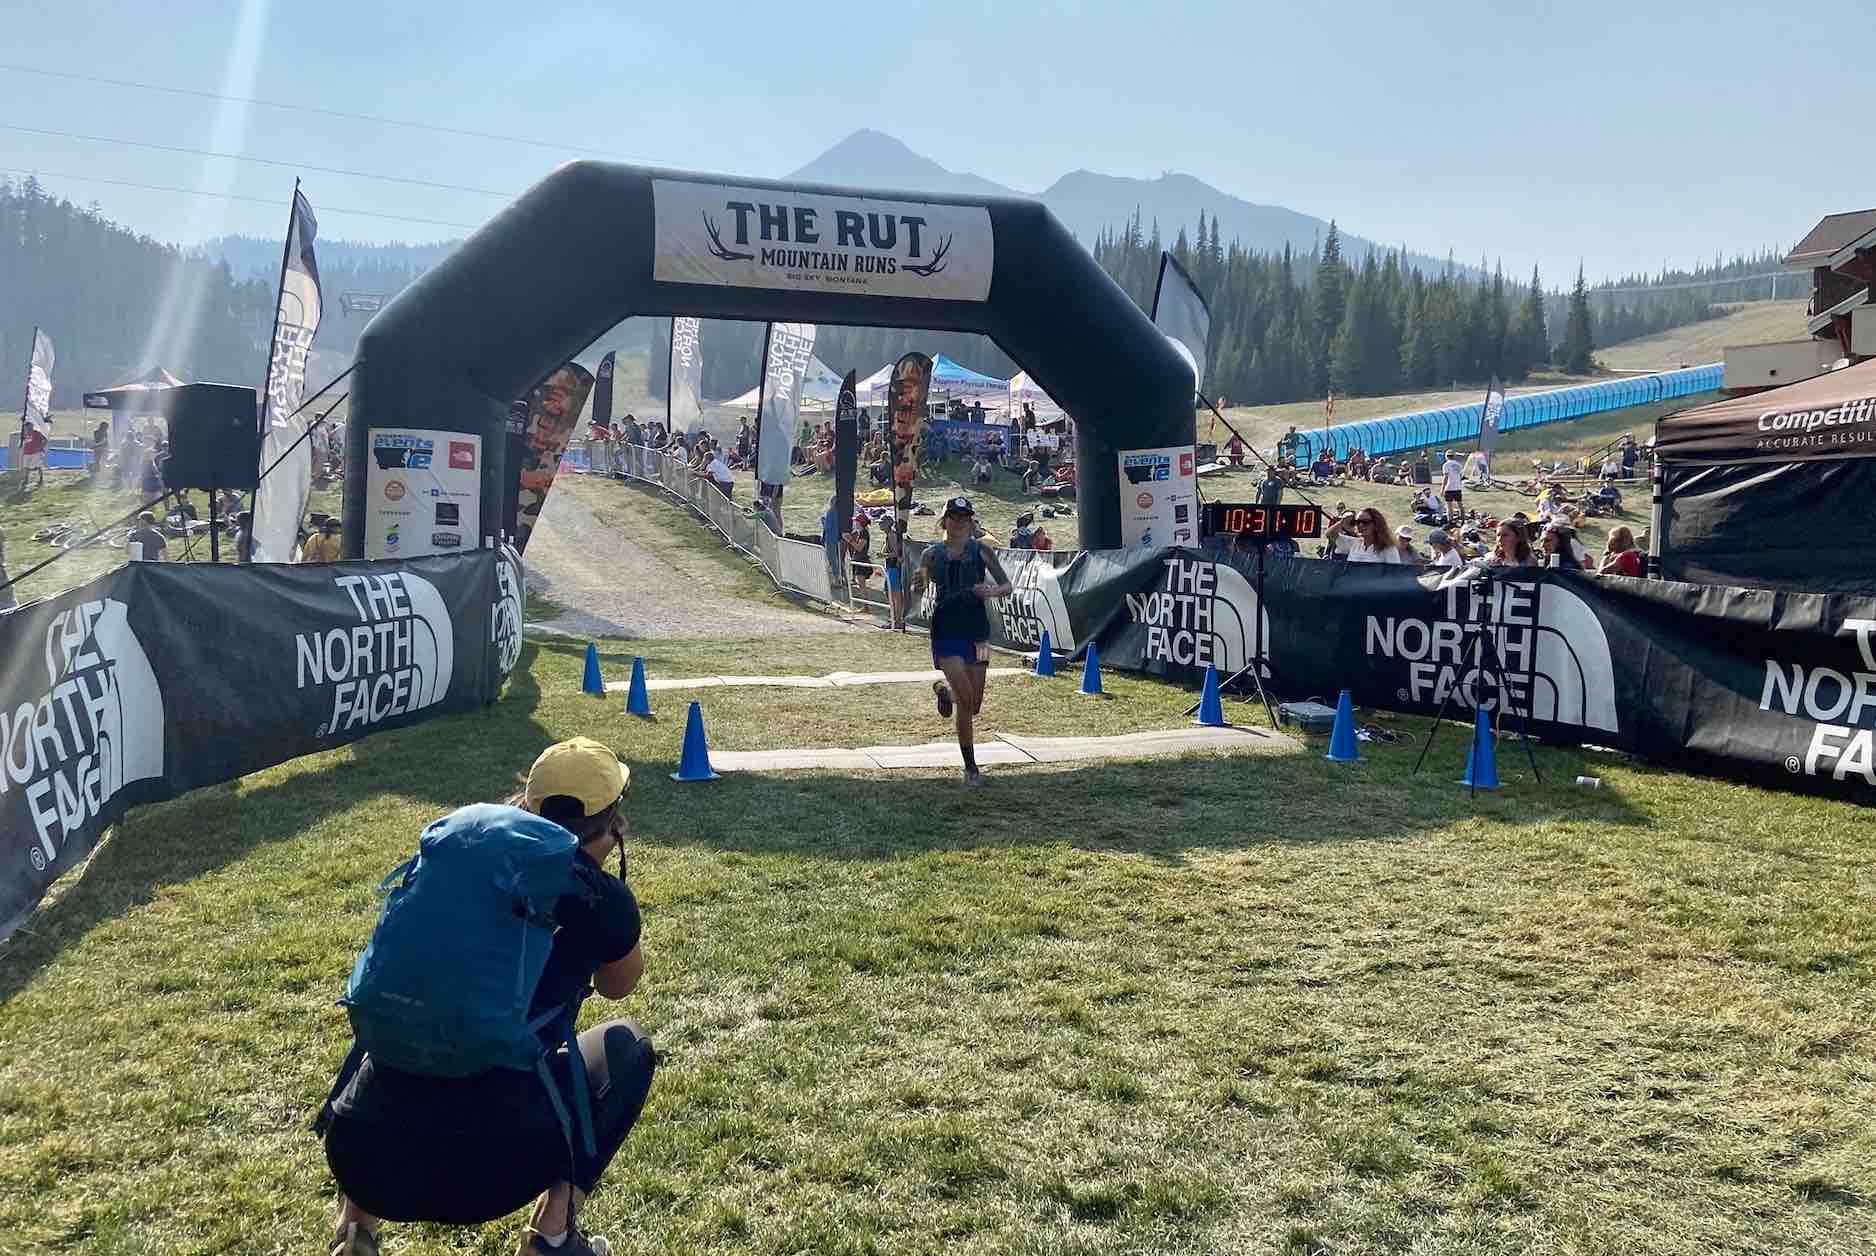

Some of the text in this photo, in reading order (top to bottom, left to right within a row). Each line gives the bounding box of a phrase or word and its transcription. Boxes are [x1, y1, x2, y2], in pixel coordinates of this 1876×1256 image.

[726, 201, 927, 258] THE RUT
[760, 247, 897, 275] MOUNTAIN RUNS
[1758, 399, 1876, 433] Competiti
[1757, 432, 1876, 449] ACCURATE RESUL
[335, 572, 411, 622] THE
[1163, 559, 1214, 596] THE
[1126, 592, 1212, 633] NORTH
[1443, 579, 1536, 625] THE
[1003, 613, 1041, 645] FACE
[1146, 626, 1213, 668] FACE
[1366, 616, 1532, 672] NORTH
[296, 619, 412, 689] NORTH
[328, 669, 411, 734] FACE
[1409, 663, 1530, 719] FACE
